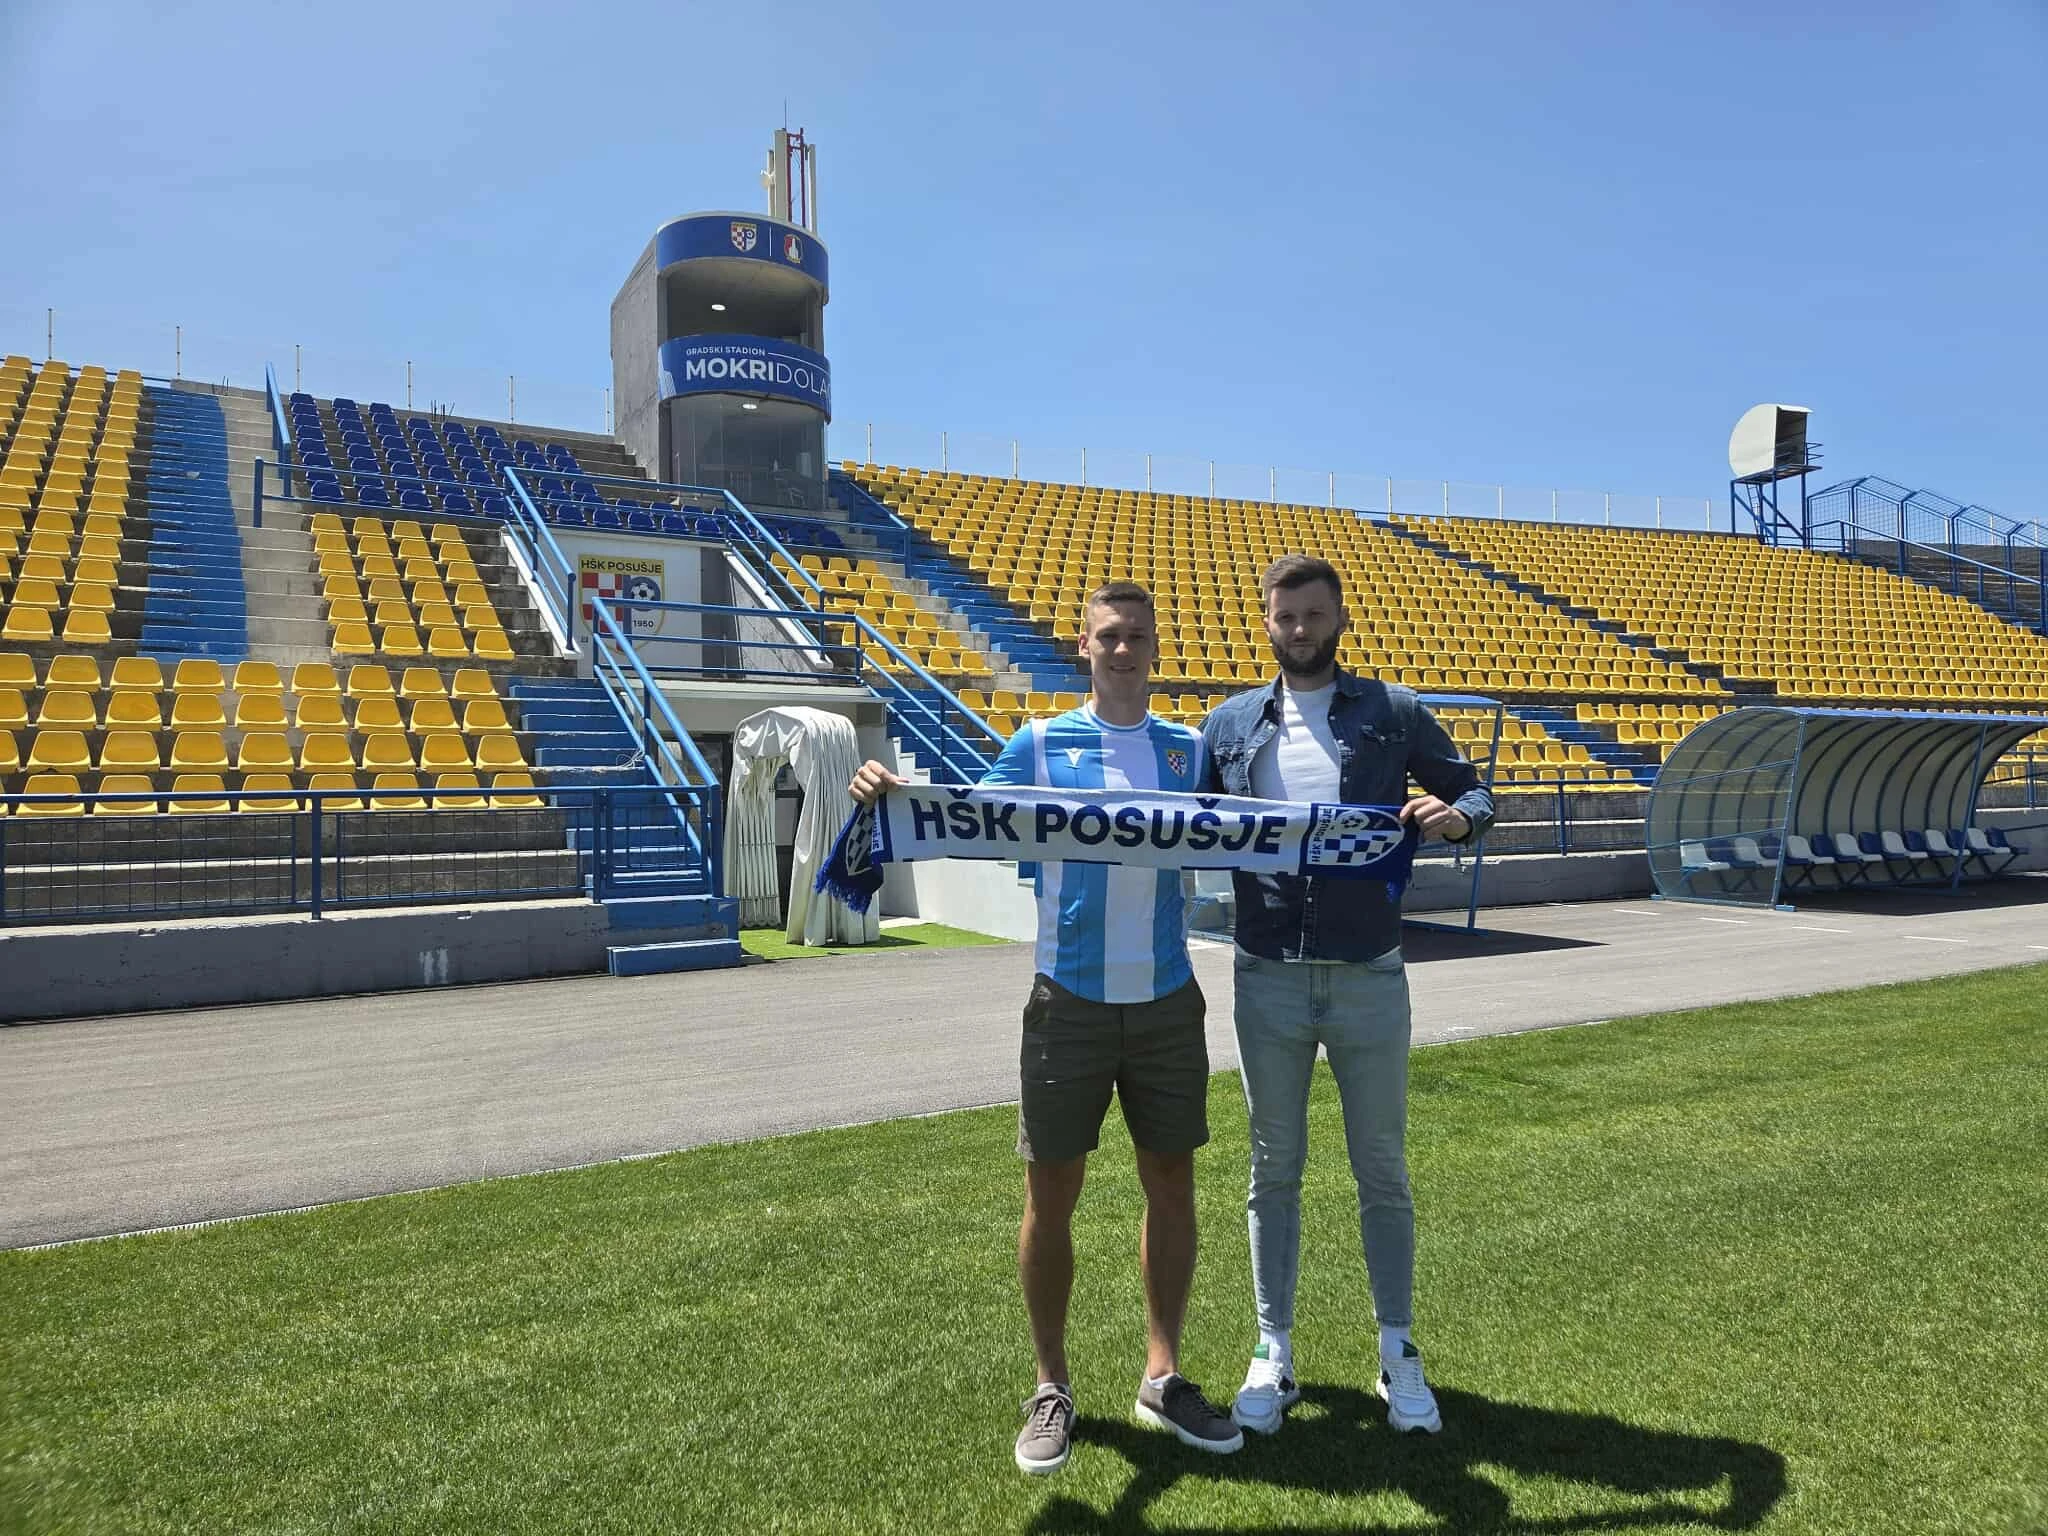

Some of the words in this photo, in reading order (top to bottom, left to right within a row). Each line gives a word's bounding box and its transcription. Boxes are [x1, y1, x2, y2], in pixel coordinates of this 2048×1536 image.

[686, 346, 723, 356] GRADSKI
[725, 346, 766, 356] STADION
[581, 558, 605, 570] HŠK
[607, 561, 662, 573] POSUŠJE
[633, 620, 654, 628] 1950
[910, 788, 1021, 842] HŠK
[1035, 798, 1288, 856] POSUŠJE
